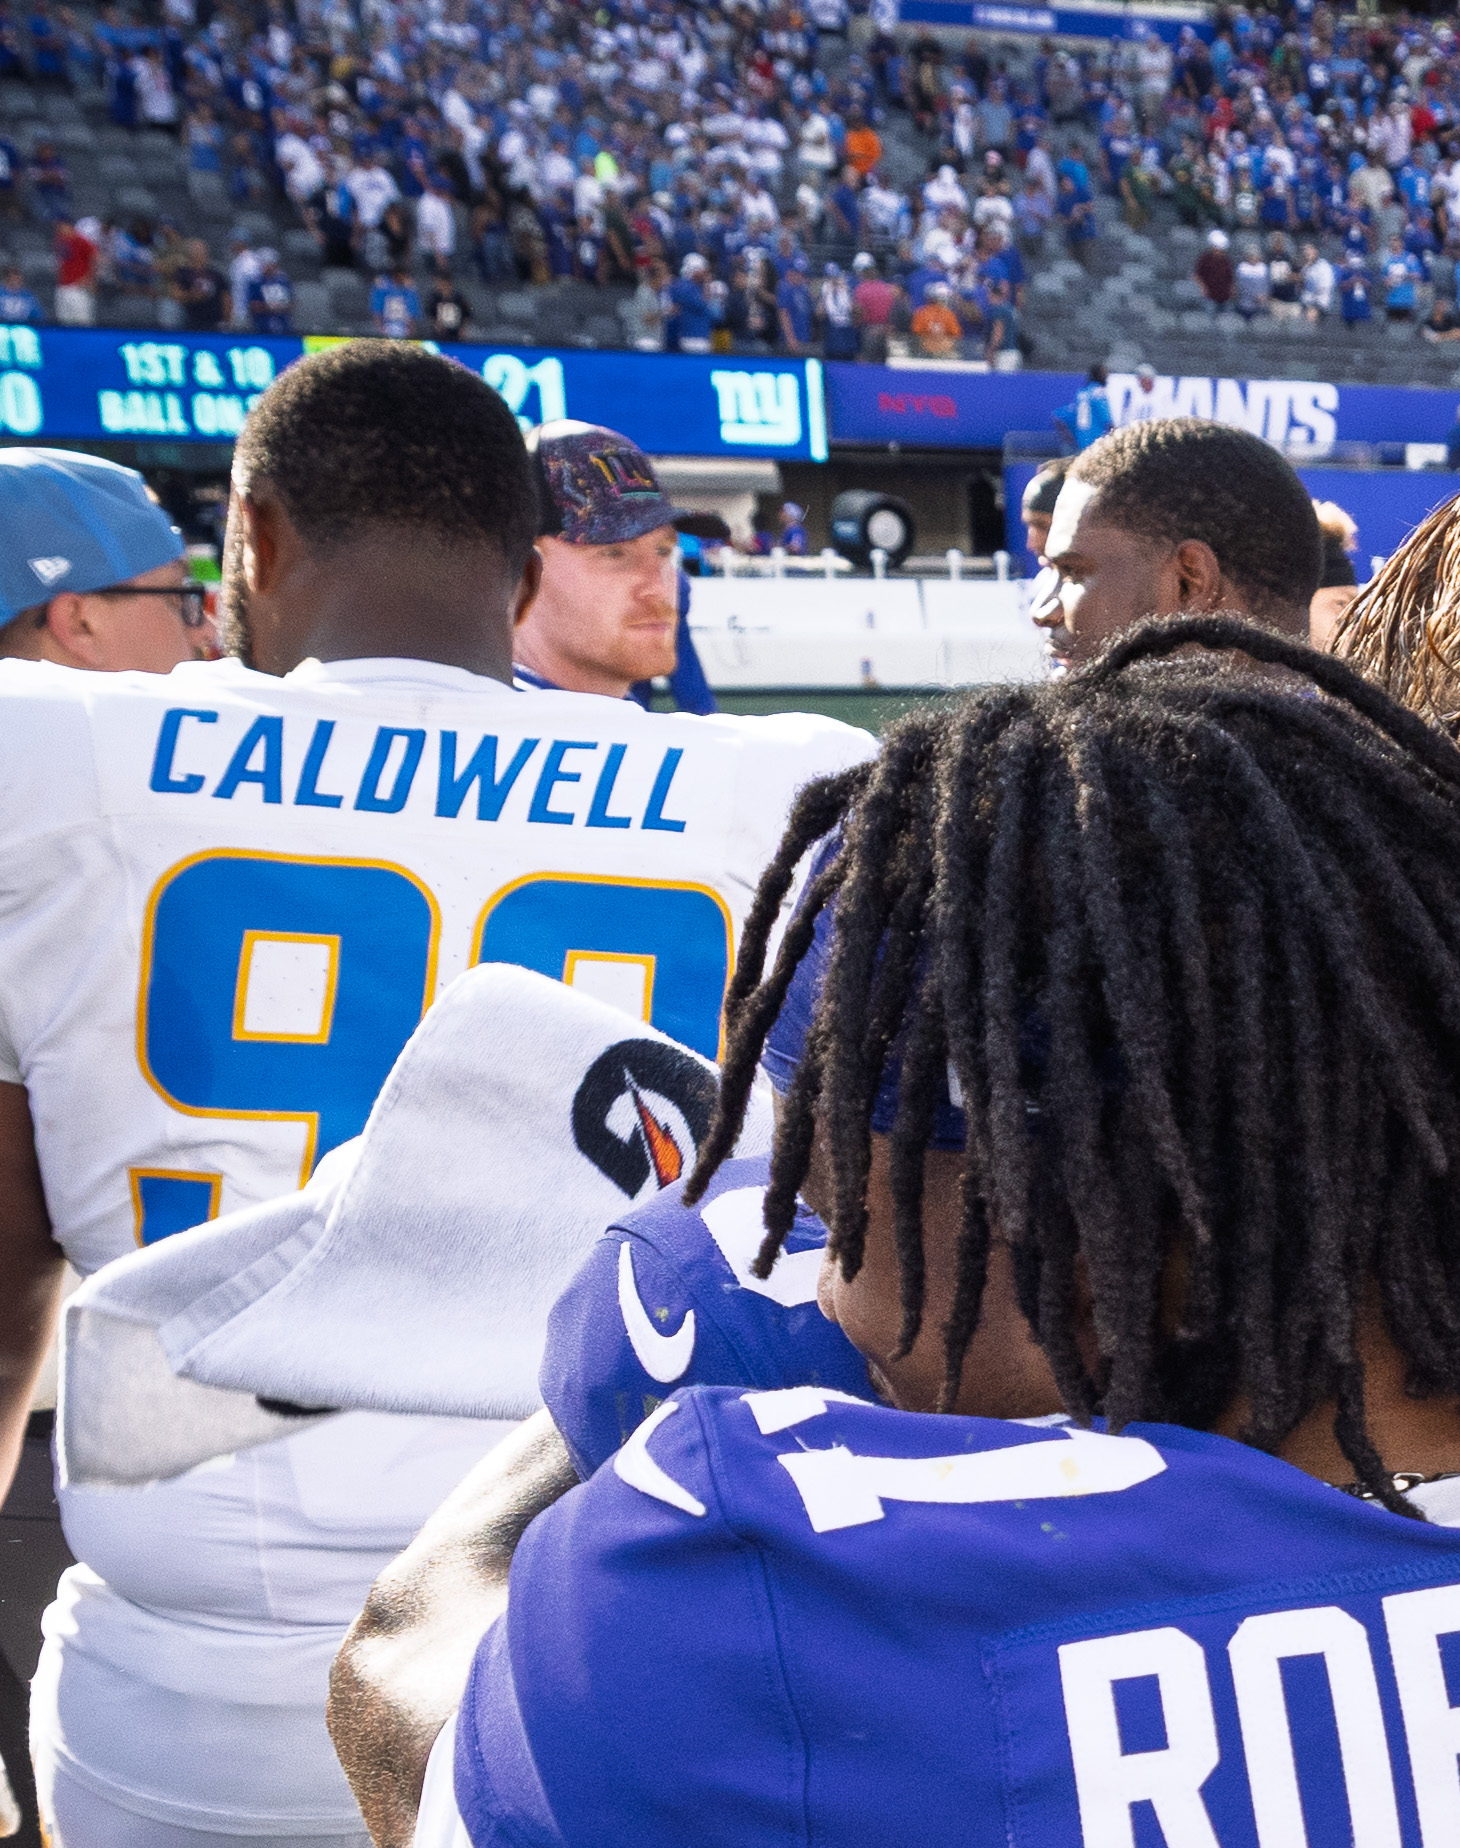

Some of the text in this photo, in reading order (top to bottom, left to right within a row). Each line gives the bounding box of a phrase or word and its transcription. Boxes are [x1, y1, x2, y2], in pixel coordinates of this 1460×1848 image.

[118, 341, 189, 387] 1ST
[482, 353, 567, 432] 21
[98, 389, 190, 433] BALL
[151, 707, 687, 833] CALDWELL
